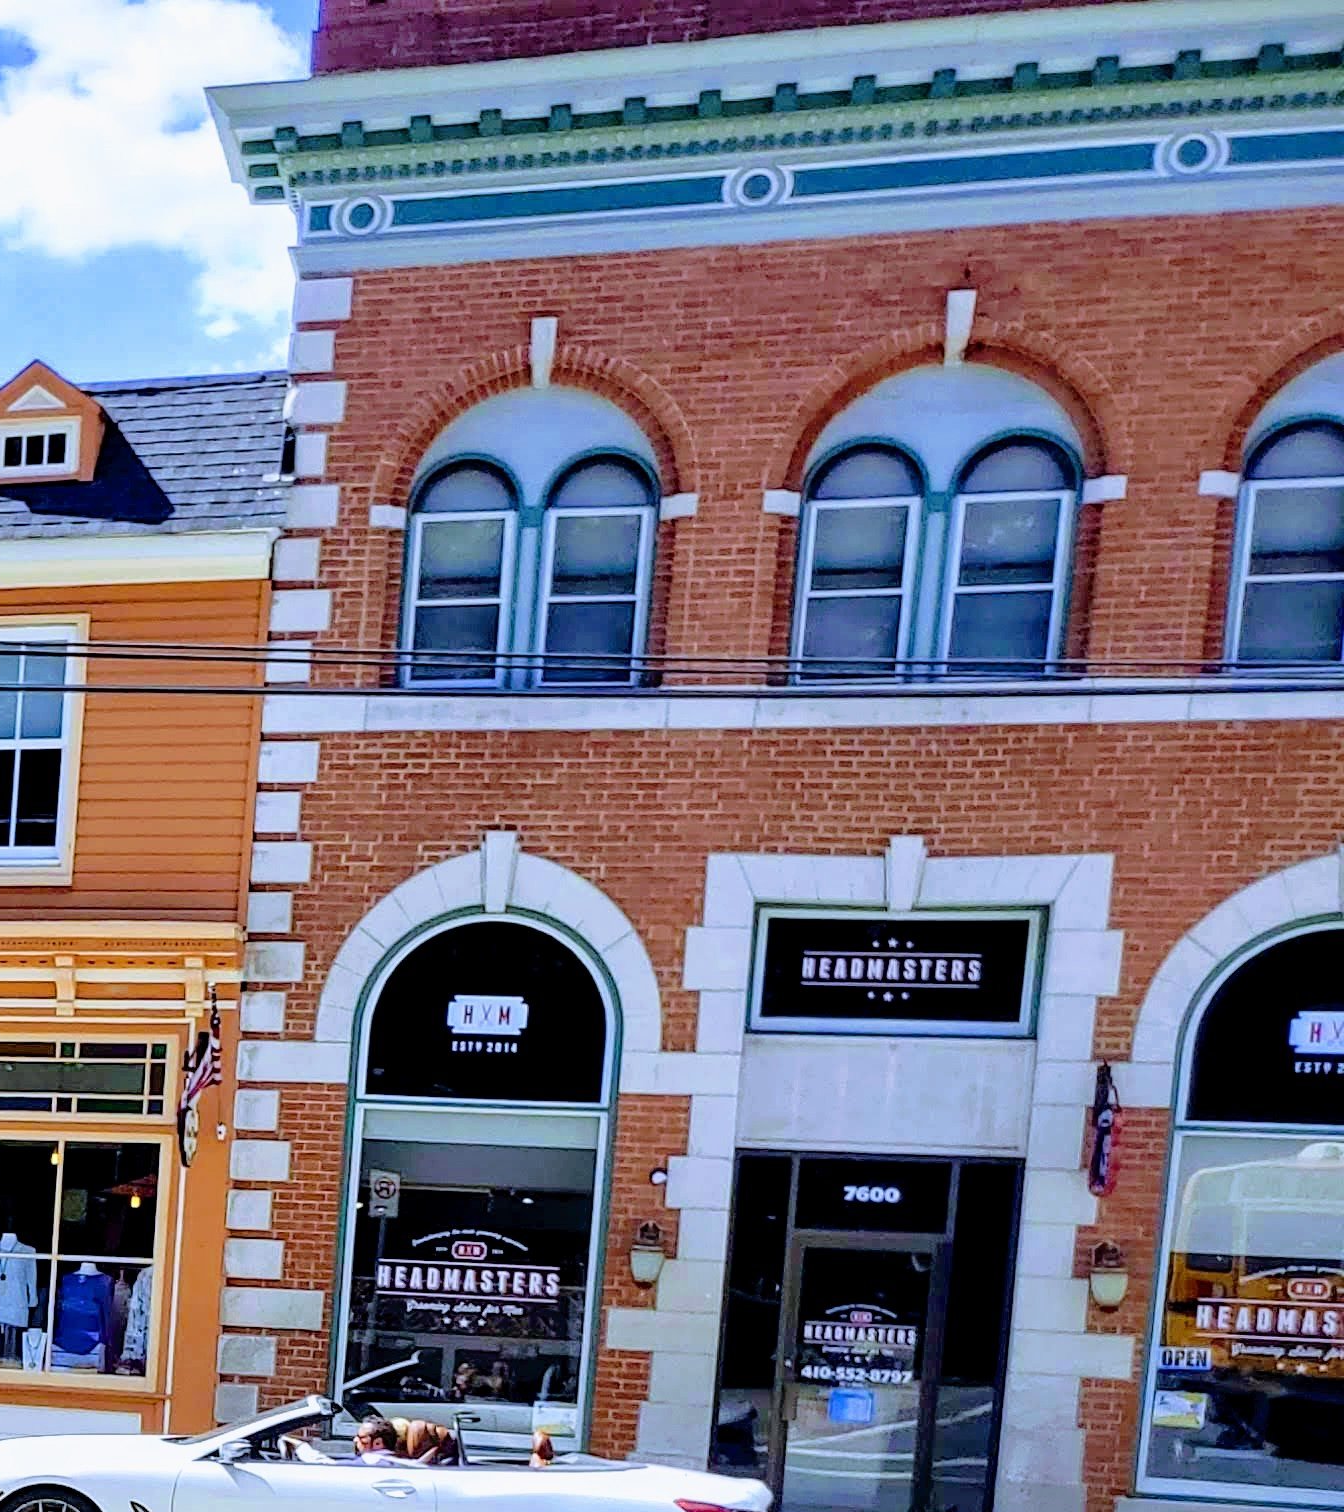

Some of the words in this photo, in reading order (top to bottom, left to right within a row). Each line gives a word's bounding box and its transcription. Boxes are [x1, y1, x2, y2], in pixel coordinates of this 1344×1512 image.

[801, 956, 983, 983] HEADMASTERS
[843, 1185, 901, 1204] 7600
[376, 1264, 561, 1298] HEADMASTERS
[803, 1324, 917, 1346] HEADMASTERS
[1161, 1349, 1208, 1368] OPEN
